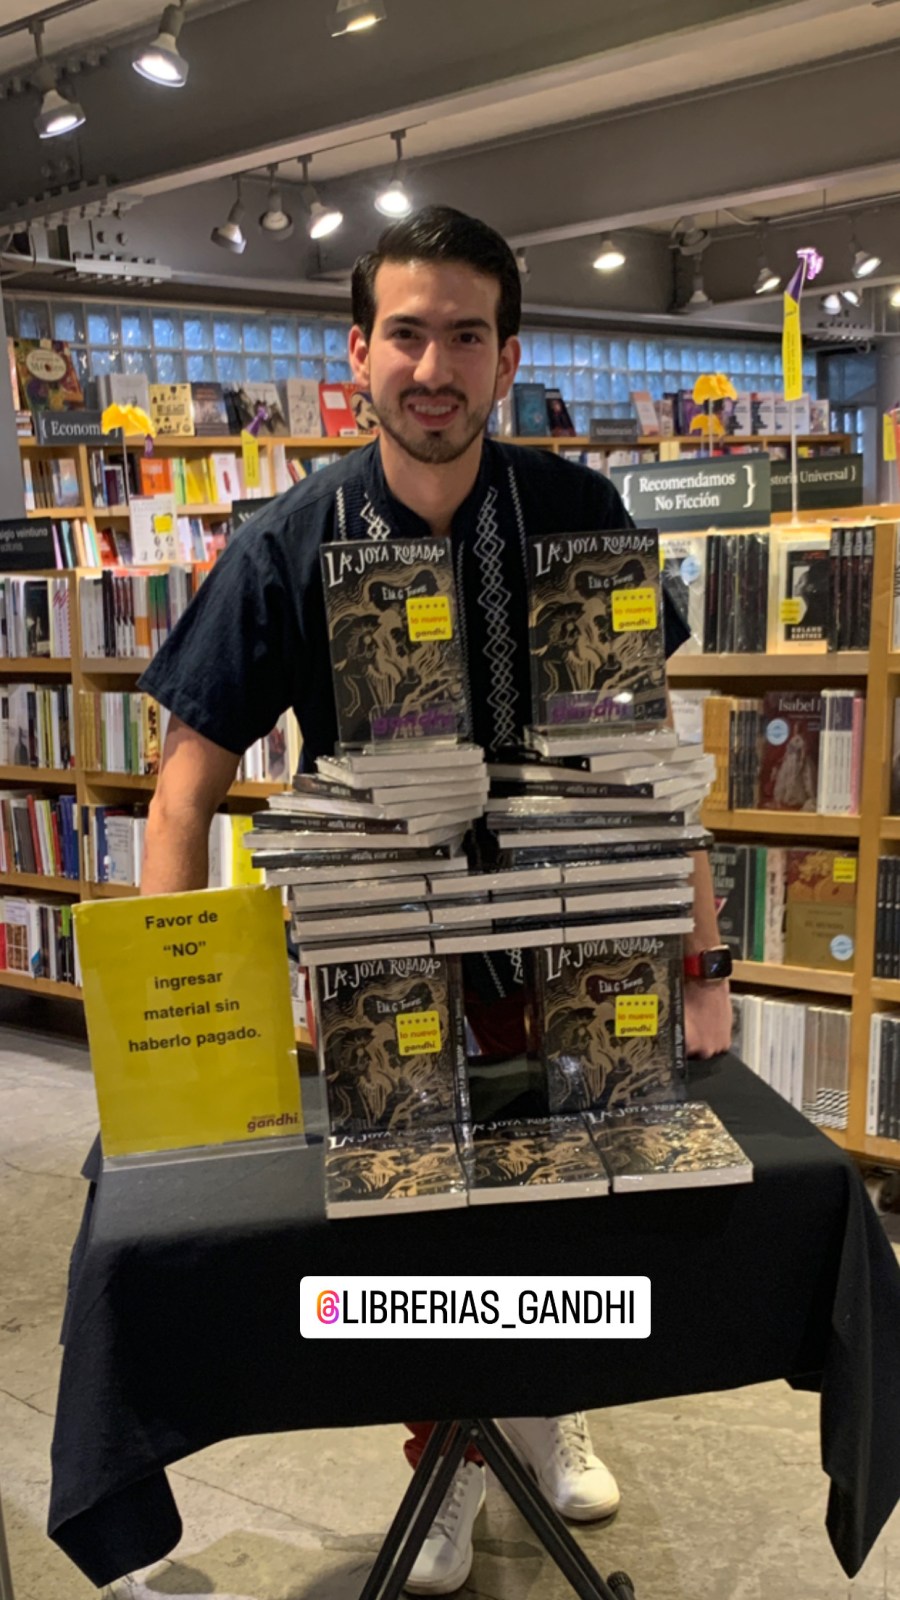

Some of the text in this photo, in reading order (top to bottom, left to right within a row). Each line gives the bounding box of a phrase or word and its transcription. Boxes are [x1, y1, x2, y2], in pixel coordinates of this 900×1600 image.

[50, 420, 101, 436] Econom
[638, 471, 736, 492] Recomendamos
[799, 466, 849, 483] Universal
[654, 491, 720, 511] No Ficción
[324, 543, 445, 588] LA JOYA ROBADA
[533, 535, 655, 577] LA JOYA ROBADA
[421, 615, 448, 625] nuevo
[625, 605, 653, 615] nuevo
[618, 617, 650, 629] gandhi
[415, 627, 446, 640] gandhi
[144, 910, 218, 930] Favor de
[544, 937, 664, 982] LA JOYA ROBADA
[154, 971, 223, 991] ingresar
[320, 957, 441, 1001] LA JOYA ROBADA
[143, 998, 240, 1021] material sin
[628, 1012, 655, 1021] nuevo
[128, 1026, 262, 1052] haberlo pagado.
[410, 1029, 438, 1038] nuevo
[619, 1024, 652, 1035] gandhi
[404, 1041, 436, 1053] gandhi
[246, 1112, 299, 1133] gandhi
